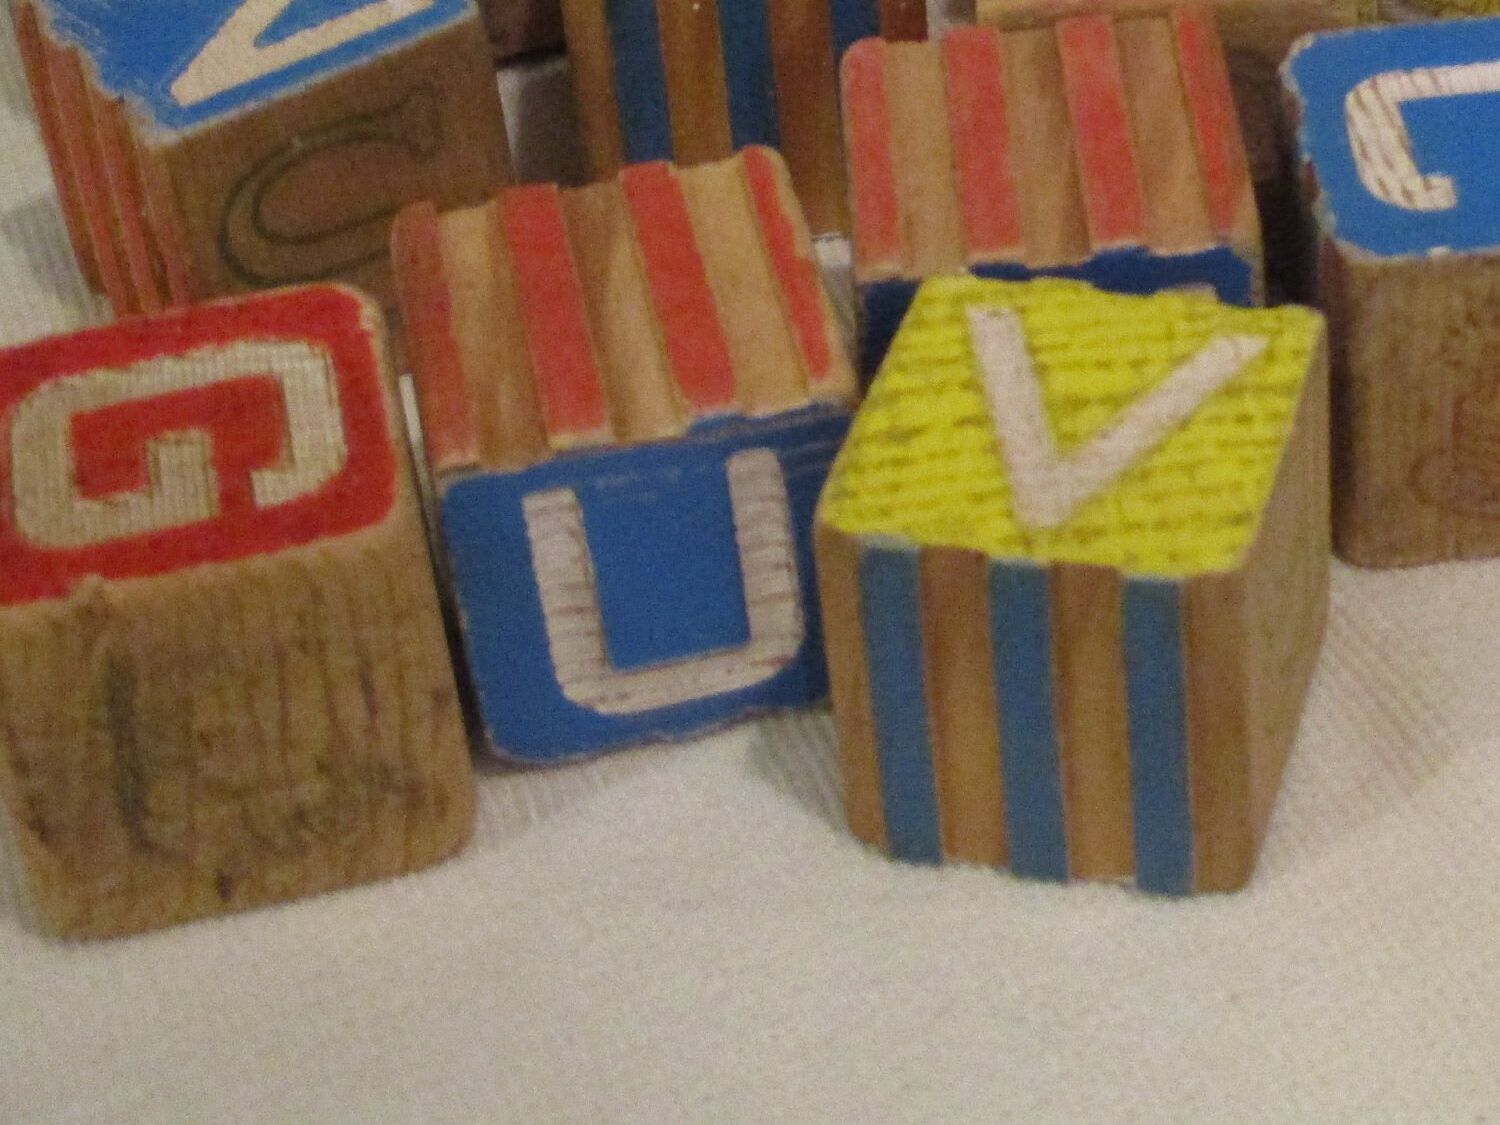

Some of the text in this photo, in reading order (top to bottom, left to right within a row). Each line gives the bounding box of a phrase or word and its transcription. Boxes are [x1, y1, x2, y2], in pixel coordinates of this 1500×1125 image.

[10, 336, 350, 550] G
[964, 302, 1271, 529] V
[520, 446, 808, 714] U
